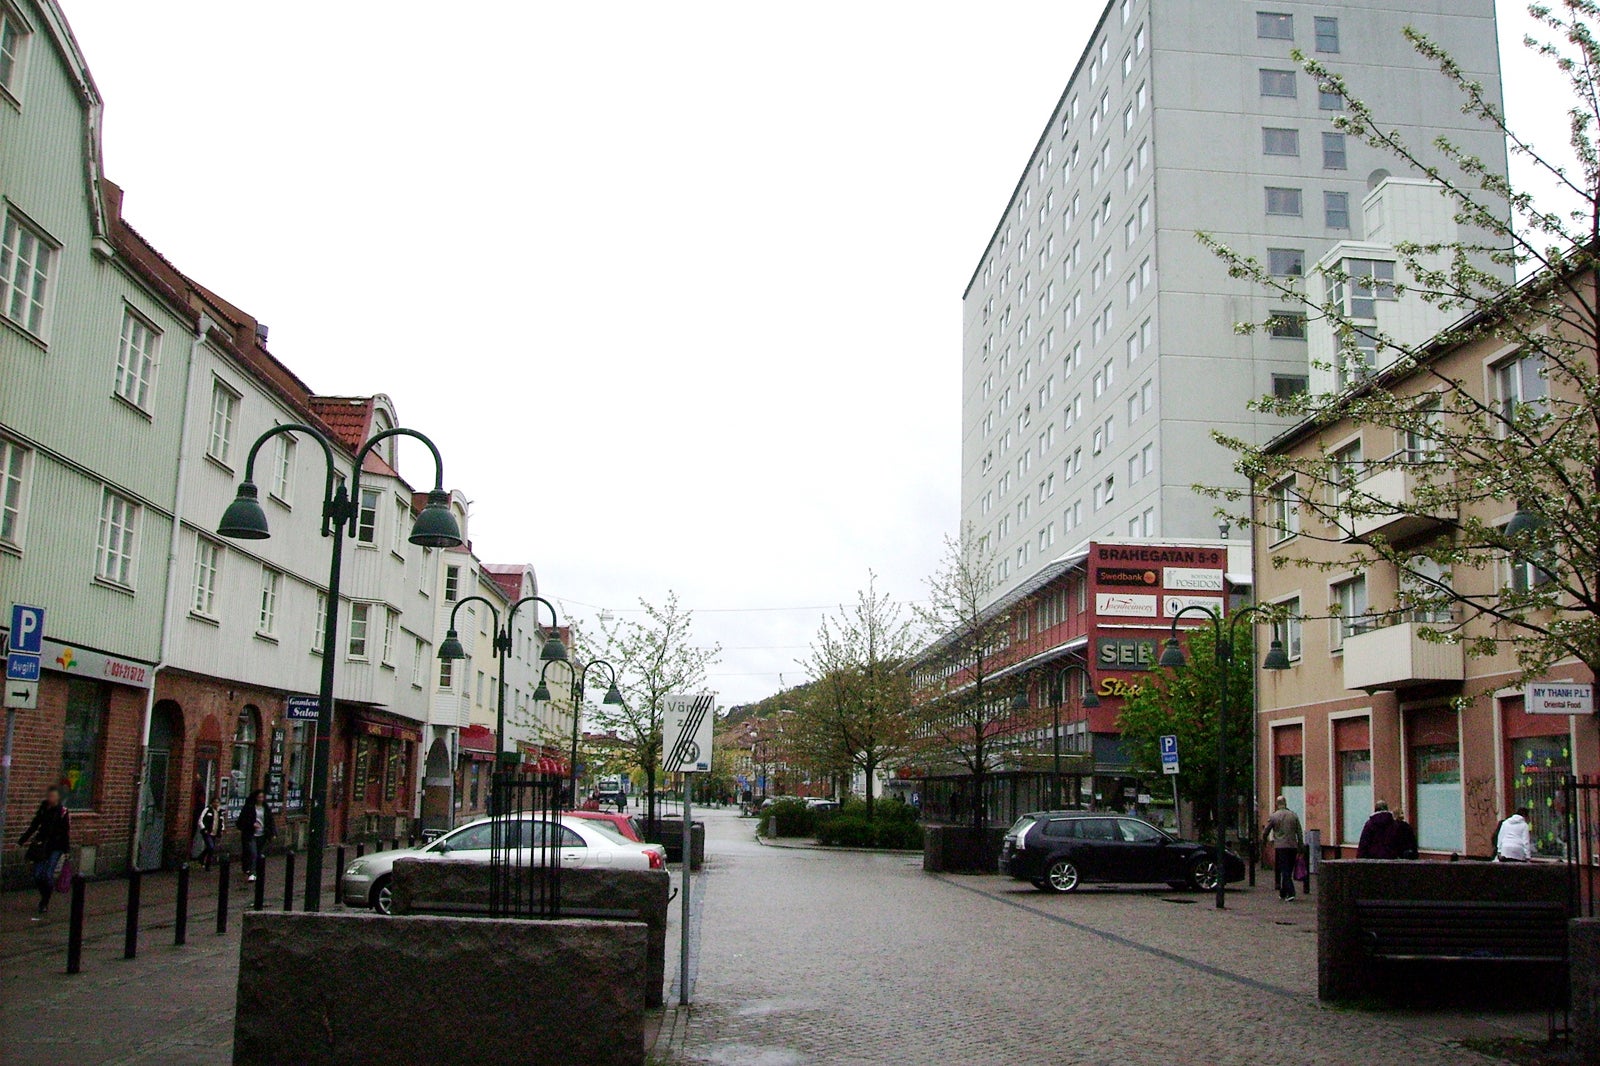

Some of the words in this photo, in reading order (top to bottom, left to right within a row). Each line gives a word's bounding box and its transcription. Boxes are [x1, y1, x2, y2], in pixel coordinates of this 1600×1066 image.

[1099, 548, 1194, 563] BRAHEGATAN
[1198, 552, 1218, 564] 5-9
[1101, 571, 1143, 581] Swedbank
[1176, 579, 1221, 589] POSEIDON
[19, 609, 37, 648] P
[1101, 643, 1153, 664] SEB
[12, 660, 36, 675] Avgift
[1534, 689, 1546, 698] MY
[1547, 689, 1573, 698] THANH
[1544, 701, 1565, 709] Oriental
[1567, 701, 1581, 709] Food
[1165, 737, 1174, 752] P
